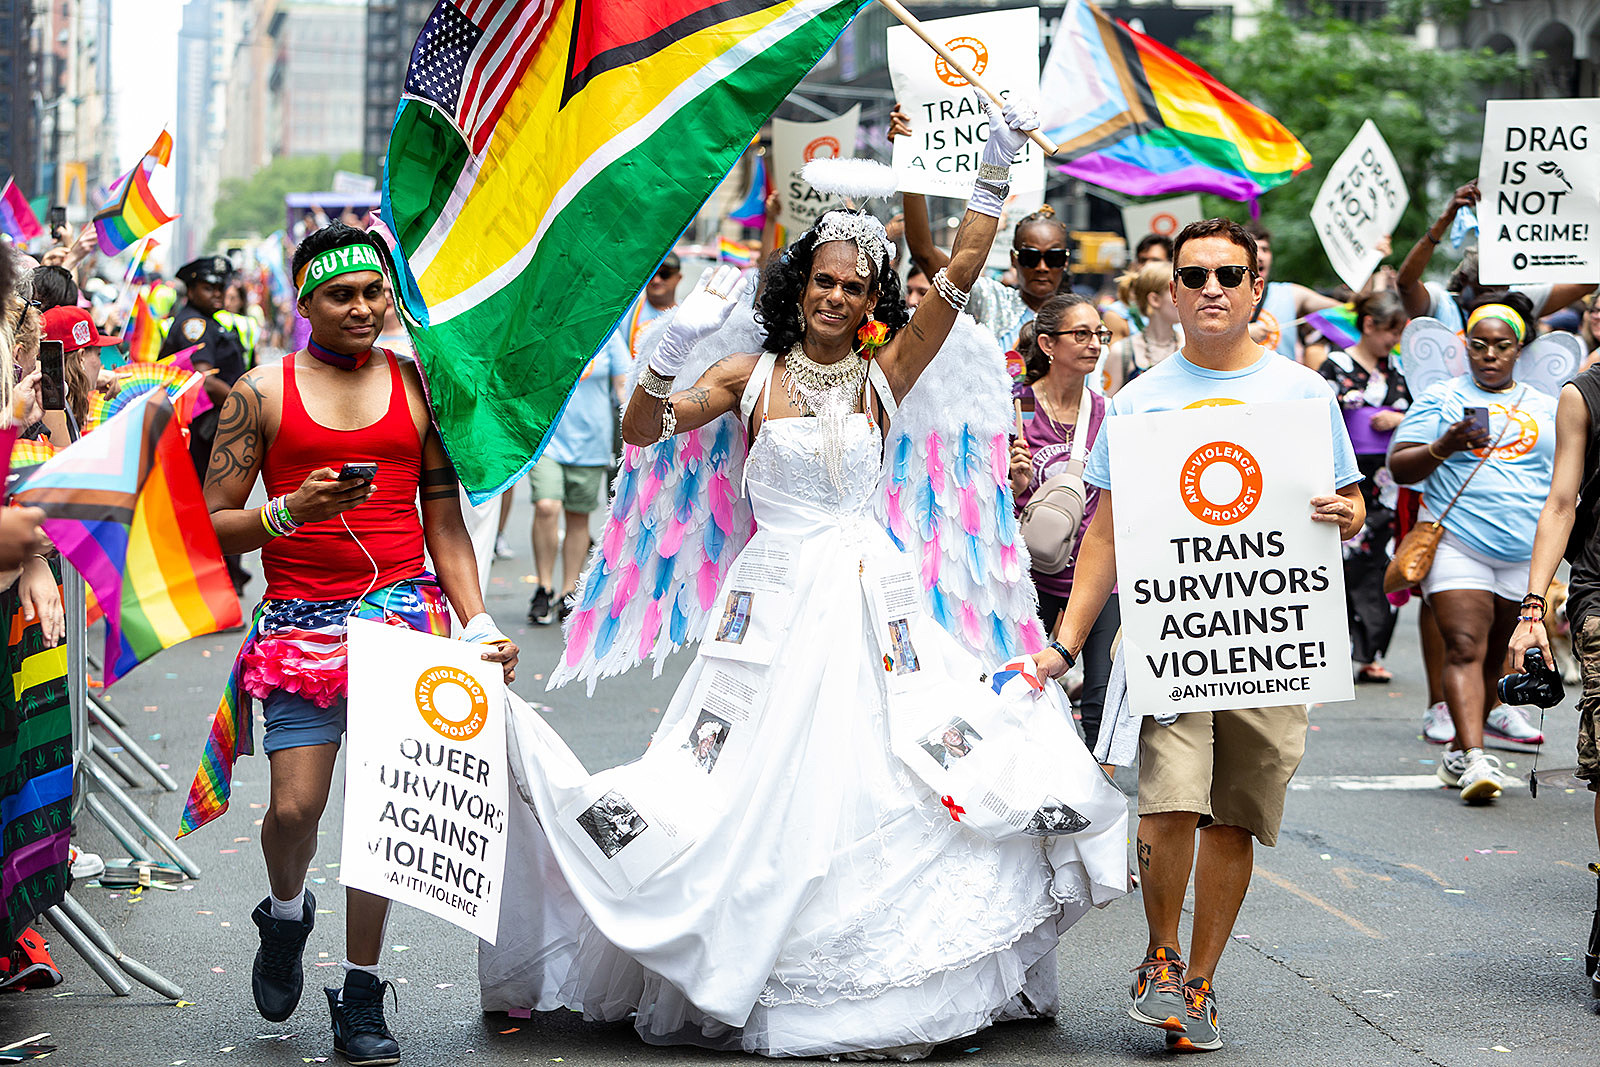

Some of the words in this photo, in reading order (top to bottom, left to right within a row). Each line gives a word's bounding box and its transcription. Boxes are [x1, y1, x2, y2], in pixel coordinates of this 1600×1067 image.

[925, 130, 946, 150] IS
[954, 122, 989, 147] NO
[1505, 125, 1588, 151] DRAG
[908, 156, 926, 170] A
[936, 143, 1030, 173] CRI!
[1500, 161, 1527, 185] IS
[1348, 165, 1365, 187] IS
[1361, 148, 1396, 209] DRAG
[1327, 200, 1335, 209] A
[1335, 181, 1371, 227] NOT
[1497, 191, 1566, 215] NOT
[1498, 224, 1512, 242] A
[1516, 224, 1589, 242] CRIME!
[1185, 446, 1256, 504] ANTI-VIOLENCE
[1202, 486, 1257, 521] PROJECT
[1170, 531, 1285, 564] TRANS
[1134, 566, 1330, 604] SURVIVORS
[1160, 604, 1309, 640] AGAINST
[1146, 641, 1327, 678] VIOLENCE!
[418, 669, 485, 712] ANTI-VIOLENCE
[1168, 677, 1311, 701] @ANTIVIOLENCE
[432, 713, 483, 737] PROJECT
[400, 738, 490, 787] QUEER
[364, 761, 504, 834] URVIVORS
[379, 801, 489, 862] AGAINST
[368, 837, 491, 903] VIOLENCE!
[384, 871, 478, 917] ANTIVIOLENCE
